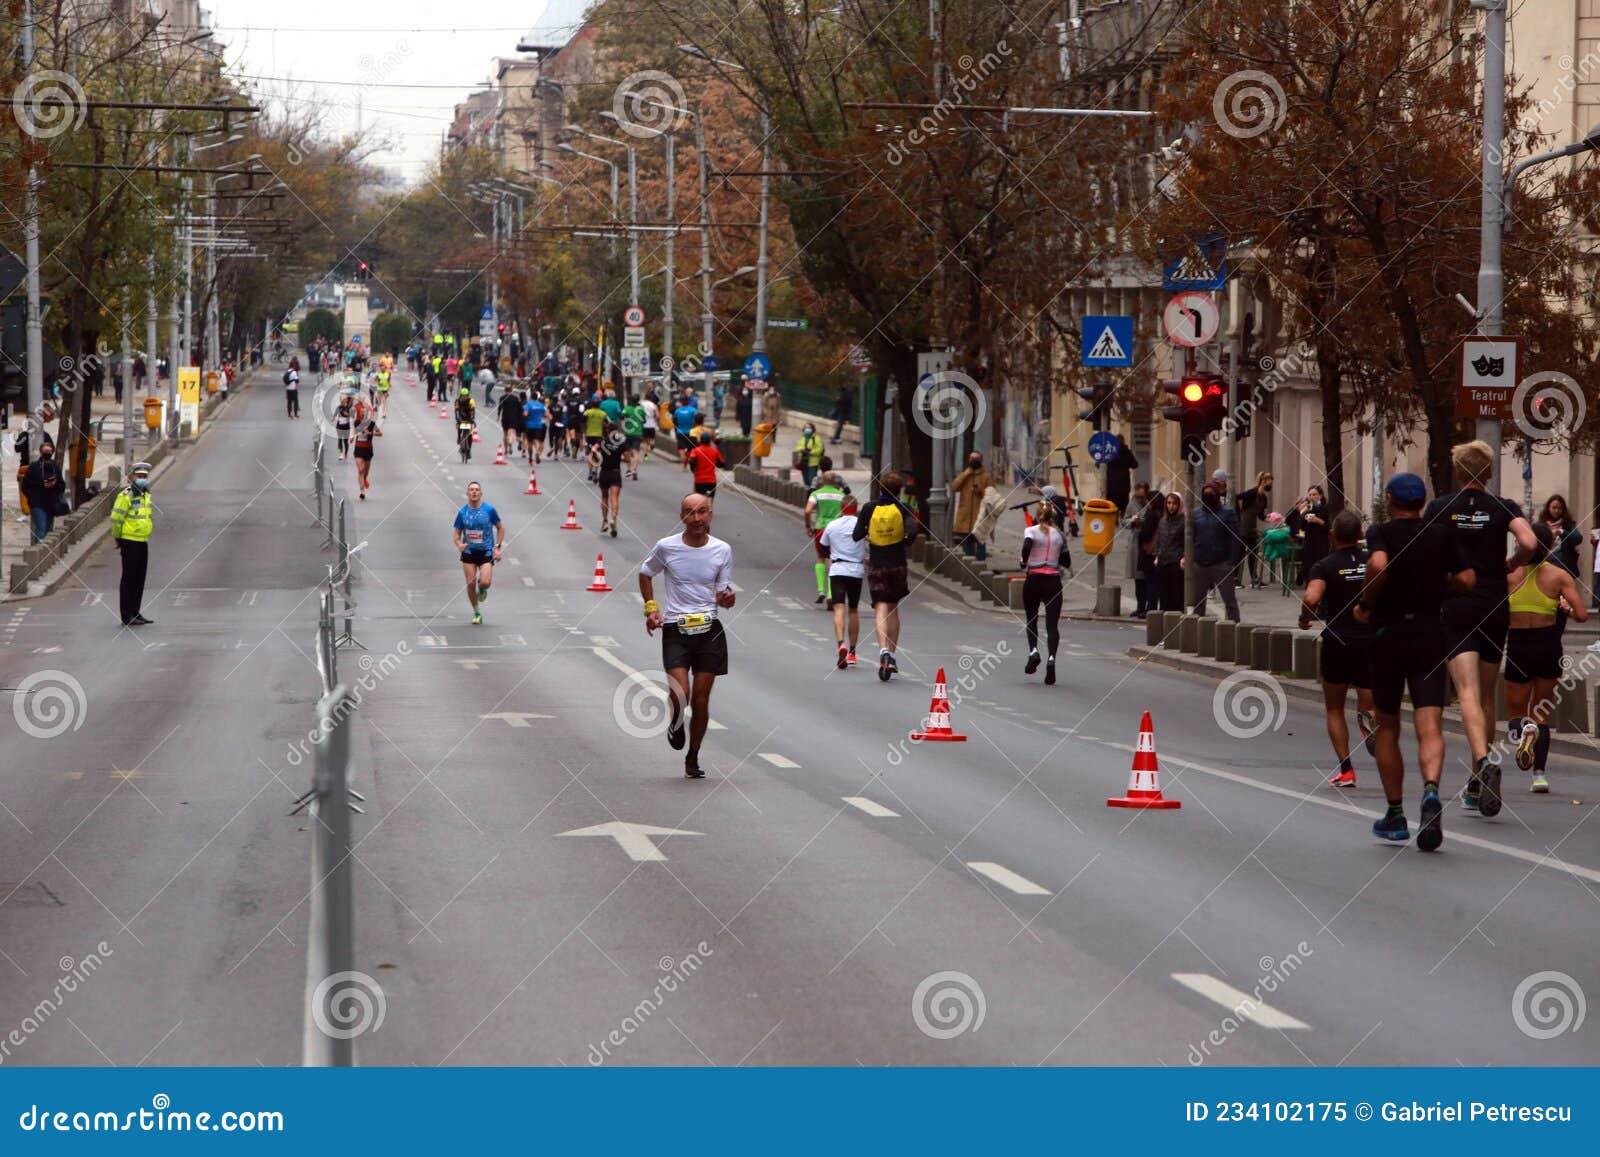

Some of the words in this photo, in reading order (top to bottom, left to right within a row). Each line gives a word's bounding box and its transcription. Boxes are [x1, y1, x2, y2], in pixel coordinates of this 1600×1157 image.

[629, 311, 640, 321] 40
[182, 381, 196, 390] 17
[1471, 390, 1507, 401] Teatrul
[1479, 404, 1497, 415] Mic
